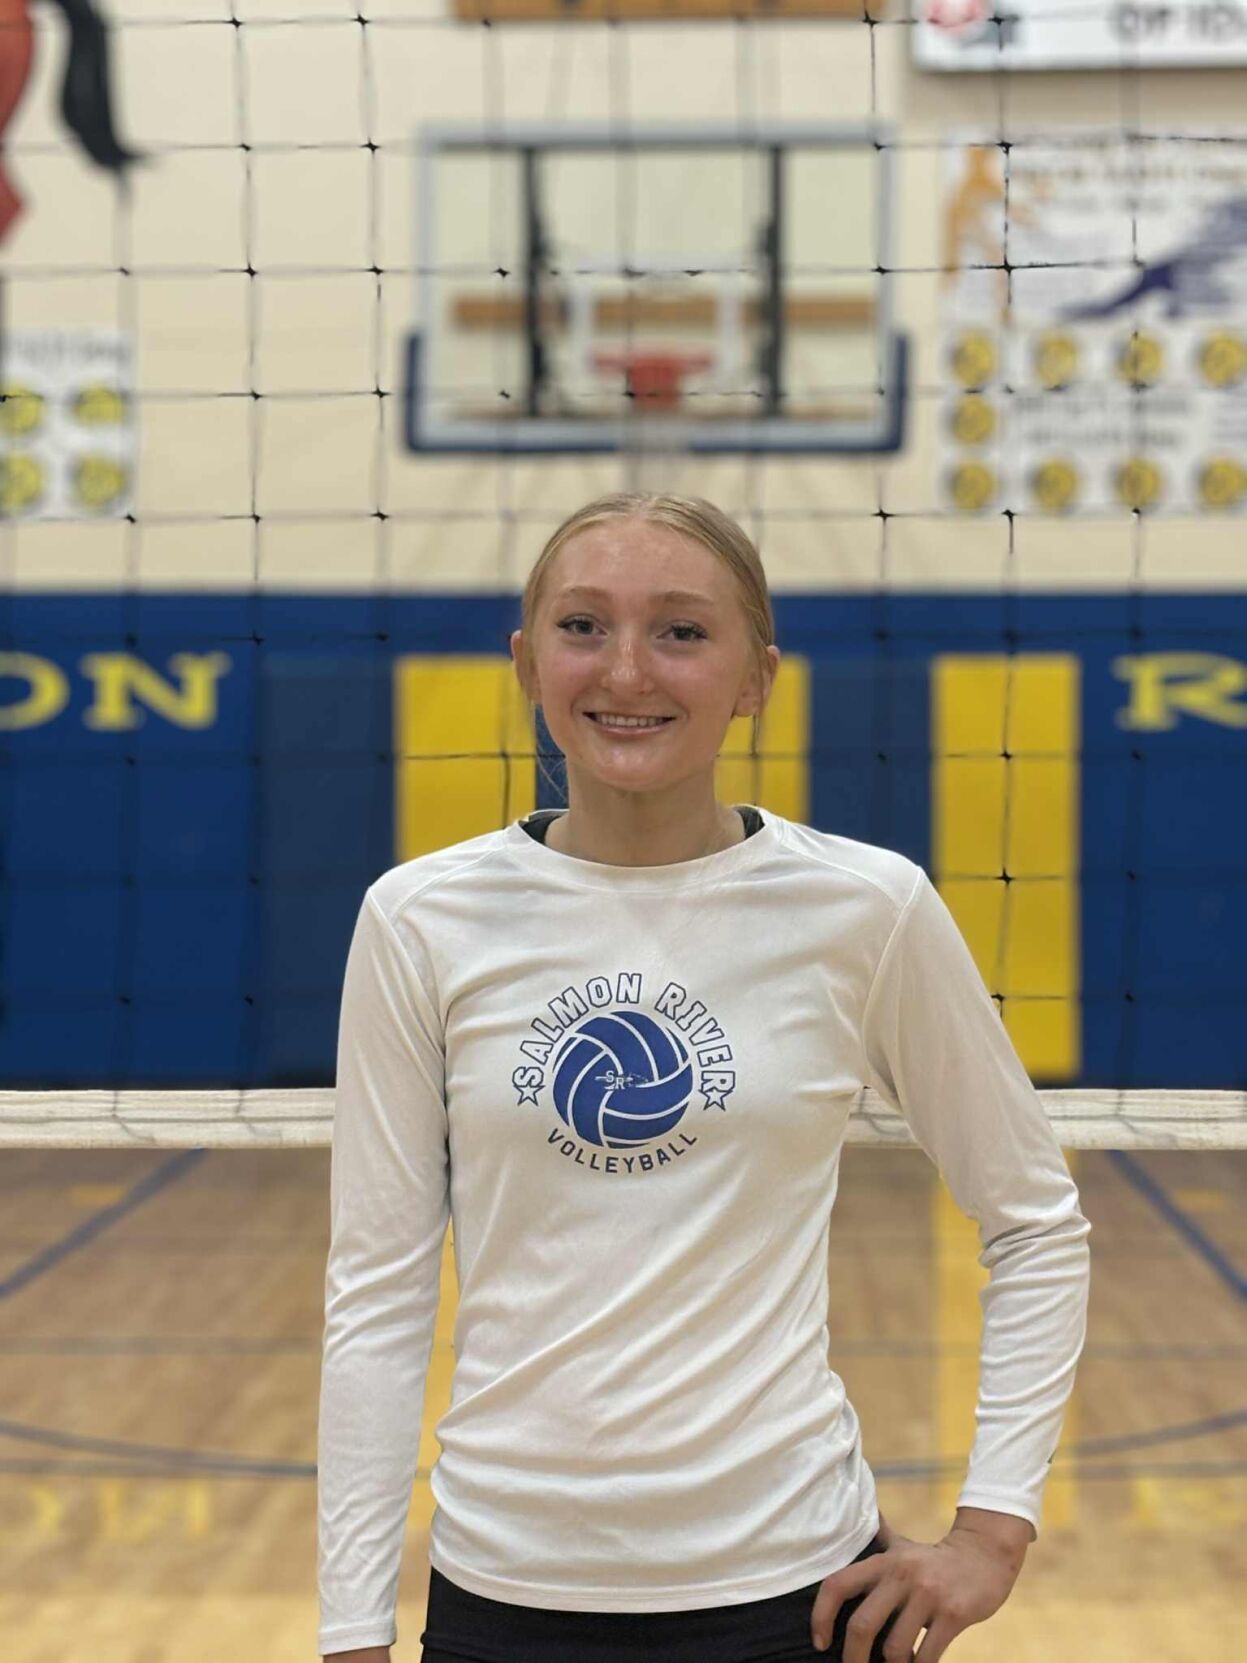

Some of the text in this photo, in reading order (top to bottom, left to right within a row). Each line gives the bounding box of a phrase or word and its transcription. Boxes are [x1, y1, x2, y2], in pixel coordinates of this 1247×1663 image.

[512, 973, 736, 1092] SALMON RIVER
[547, 1127, 698, 1173] VOLLEYBALL
